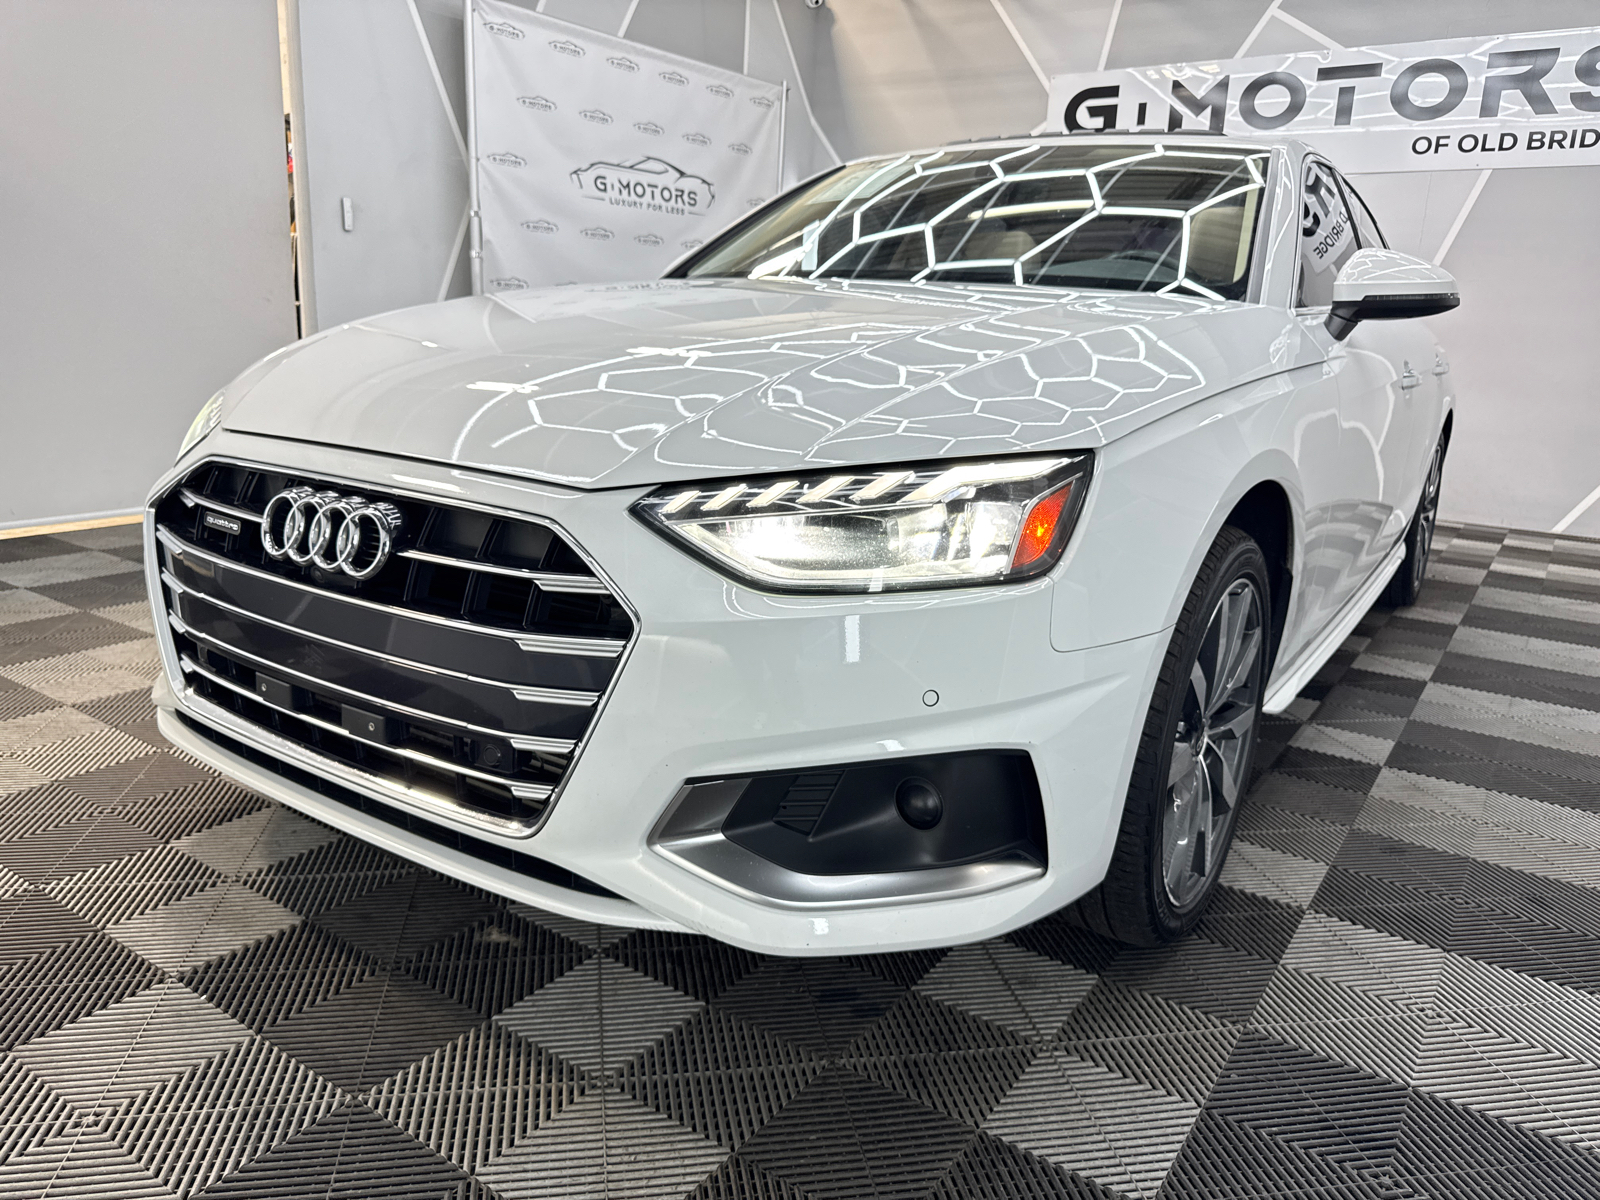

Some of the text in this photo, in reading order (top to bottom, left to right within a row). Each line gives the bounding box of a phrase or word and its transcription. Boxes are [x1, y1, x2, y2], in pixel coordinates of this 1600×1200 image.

[1411, 128, 1600, 155] OF OLD BRID
[609, 197, 686, 216] LUXURY FOR LESS
[206, 516, 239, 531] quattro
